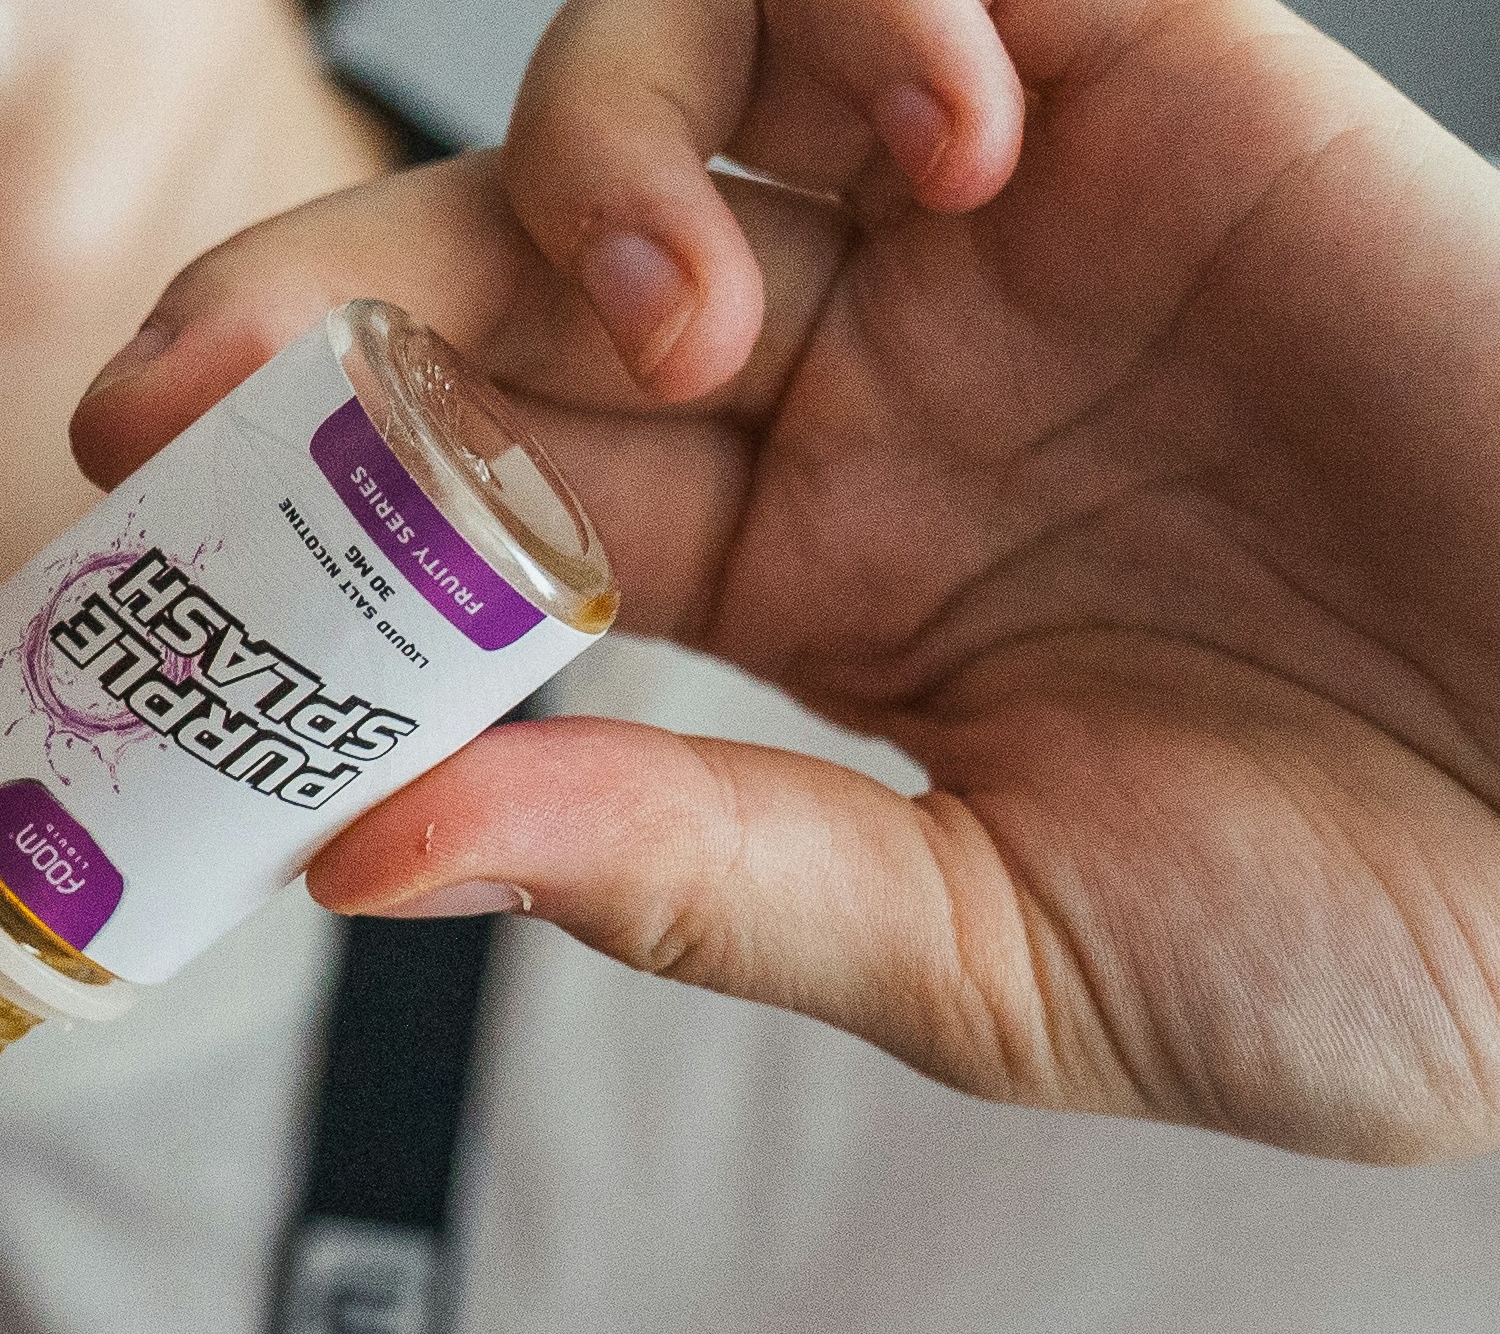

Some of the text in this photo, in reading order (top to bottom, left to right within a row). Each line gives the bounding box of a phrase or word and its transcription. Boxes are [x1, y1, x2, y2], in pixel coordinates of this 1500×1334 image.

[278, 497, 430, 669] LIQUID SALT NICOTINE
[344, 545, 396, 603] 30 MG
[350, 466, 484, 616] FRUITY SERIES
[49, 591, 362, 810] PURPLE
[108, 547, 420, 761] SPLASH
[16, 823, 86, 894] FOOM
[46, 824, 89, 870] LIQUID
